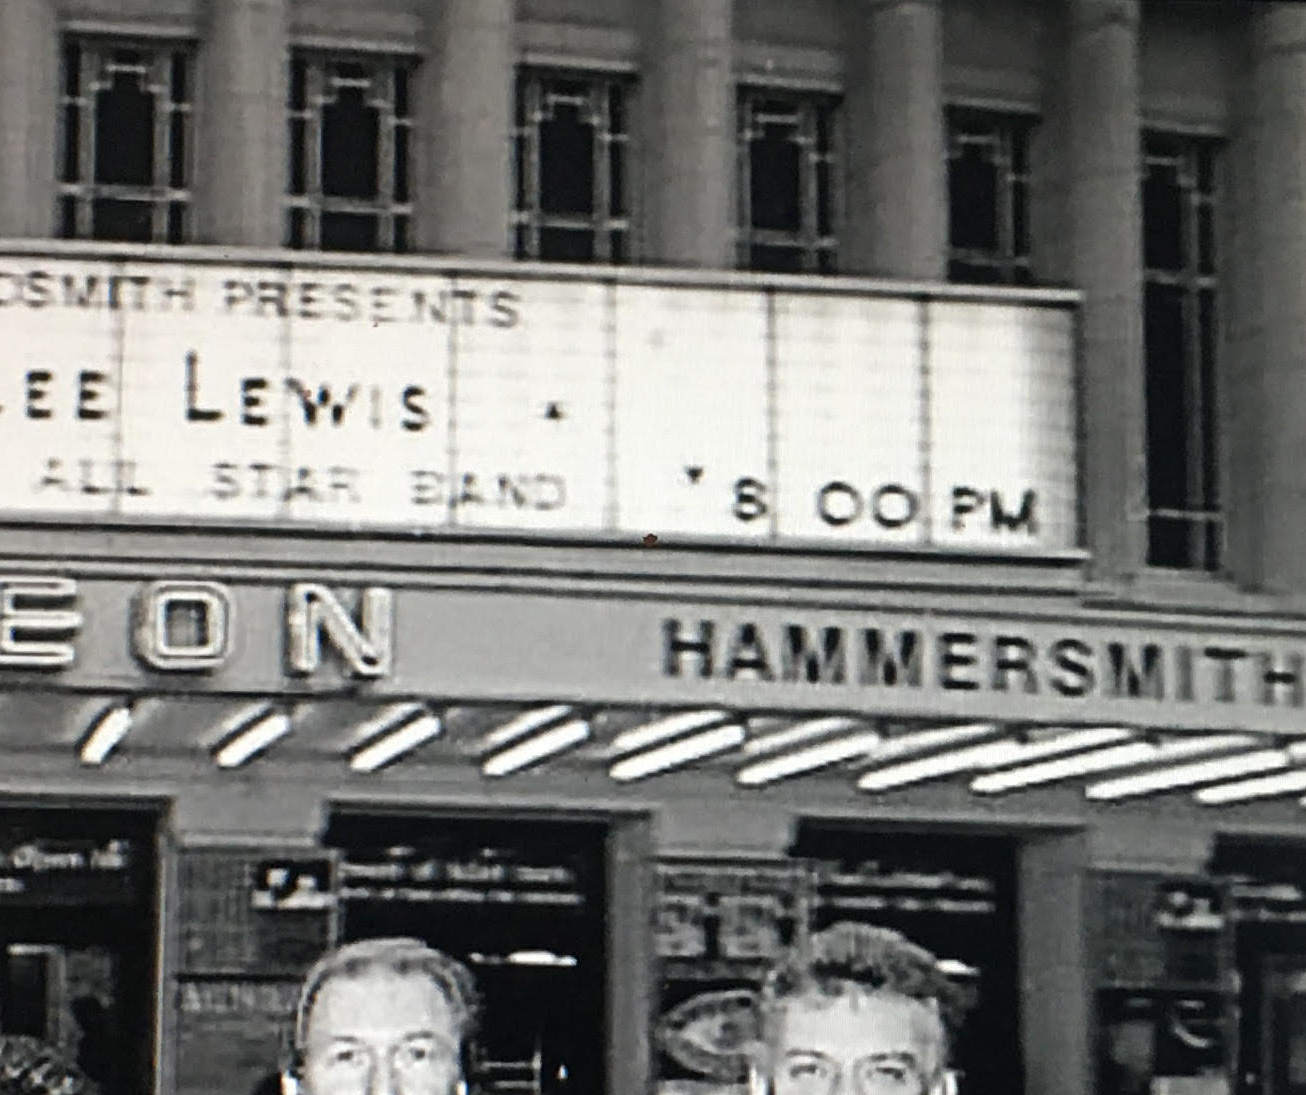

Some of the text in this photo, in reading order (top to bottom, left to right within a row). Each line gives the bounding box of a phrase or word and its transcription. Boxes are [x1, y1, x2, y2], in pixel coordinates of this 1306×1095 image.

[222, 279, 522, 329] PRESENTS
[34, 457, 152, 497] ALL
[212, 461, 363, 504] STAR
[409, 468, 568, 512] BAND
[949, 485, 1037, 534] PM
[660, 618, 1305, 708] HAMMERSMITH
